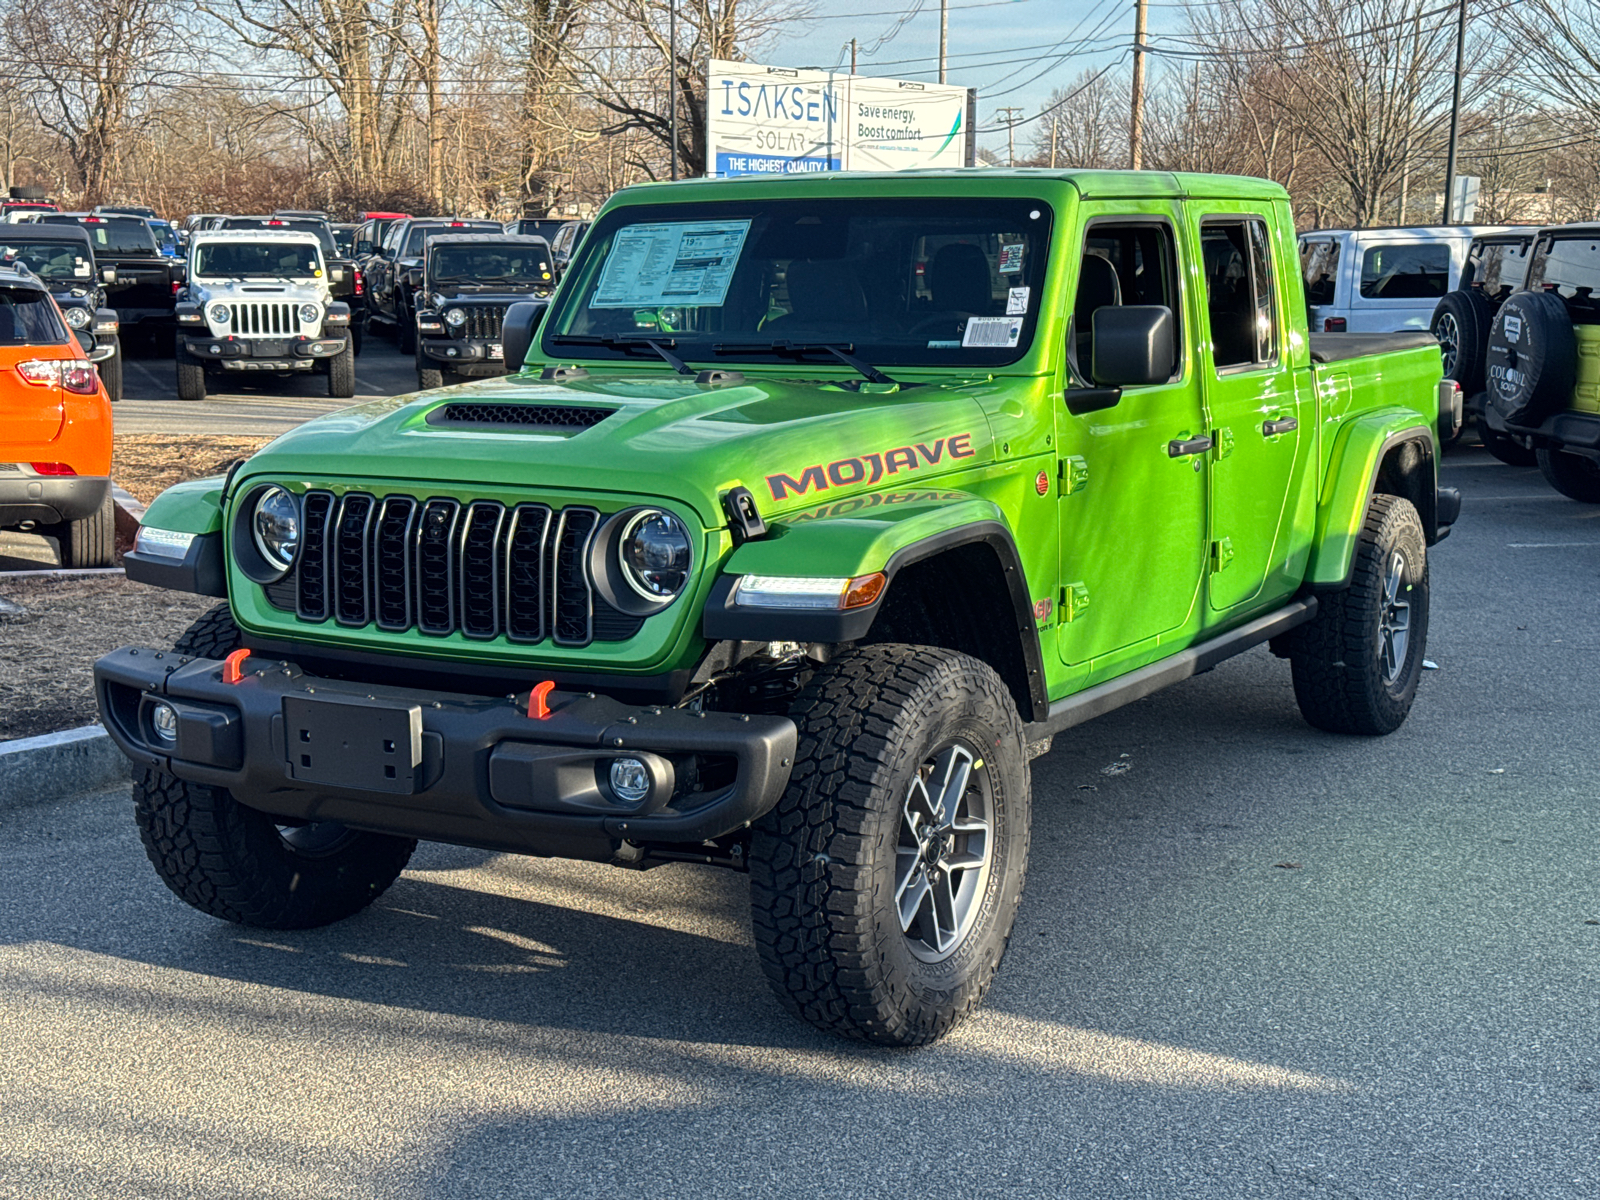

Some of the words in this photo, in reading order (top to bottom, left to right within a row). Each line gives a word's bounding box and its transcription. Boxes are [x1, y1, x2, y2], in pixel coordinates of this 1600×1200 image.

[721, 80, 837, 123] ISAKSEN
[858, 103, 880, 118] Save
[882, 108, 915, 124] energy.
[756, 130, 805, 151] SOLAR
[858, 123, 885, 139] Boost
[886, 126, 923, 140] comfort.
[728, 157, 747, 171] THE
[748, 159, 785, 172] HIGHEST
[787, 160, 824, 173] QUALITY
[1508, 318, 1519, 330] Jeep
[765, 433, 975, 501] MOJAVE
